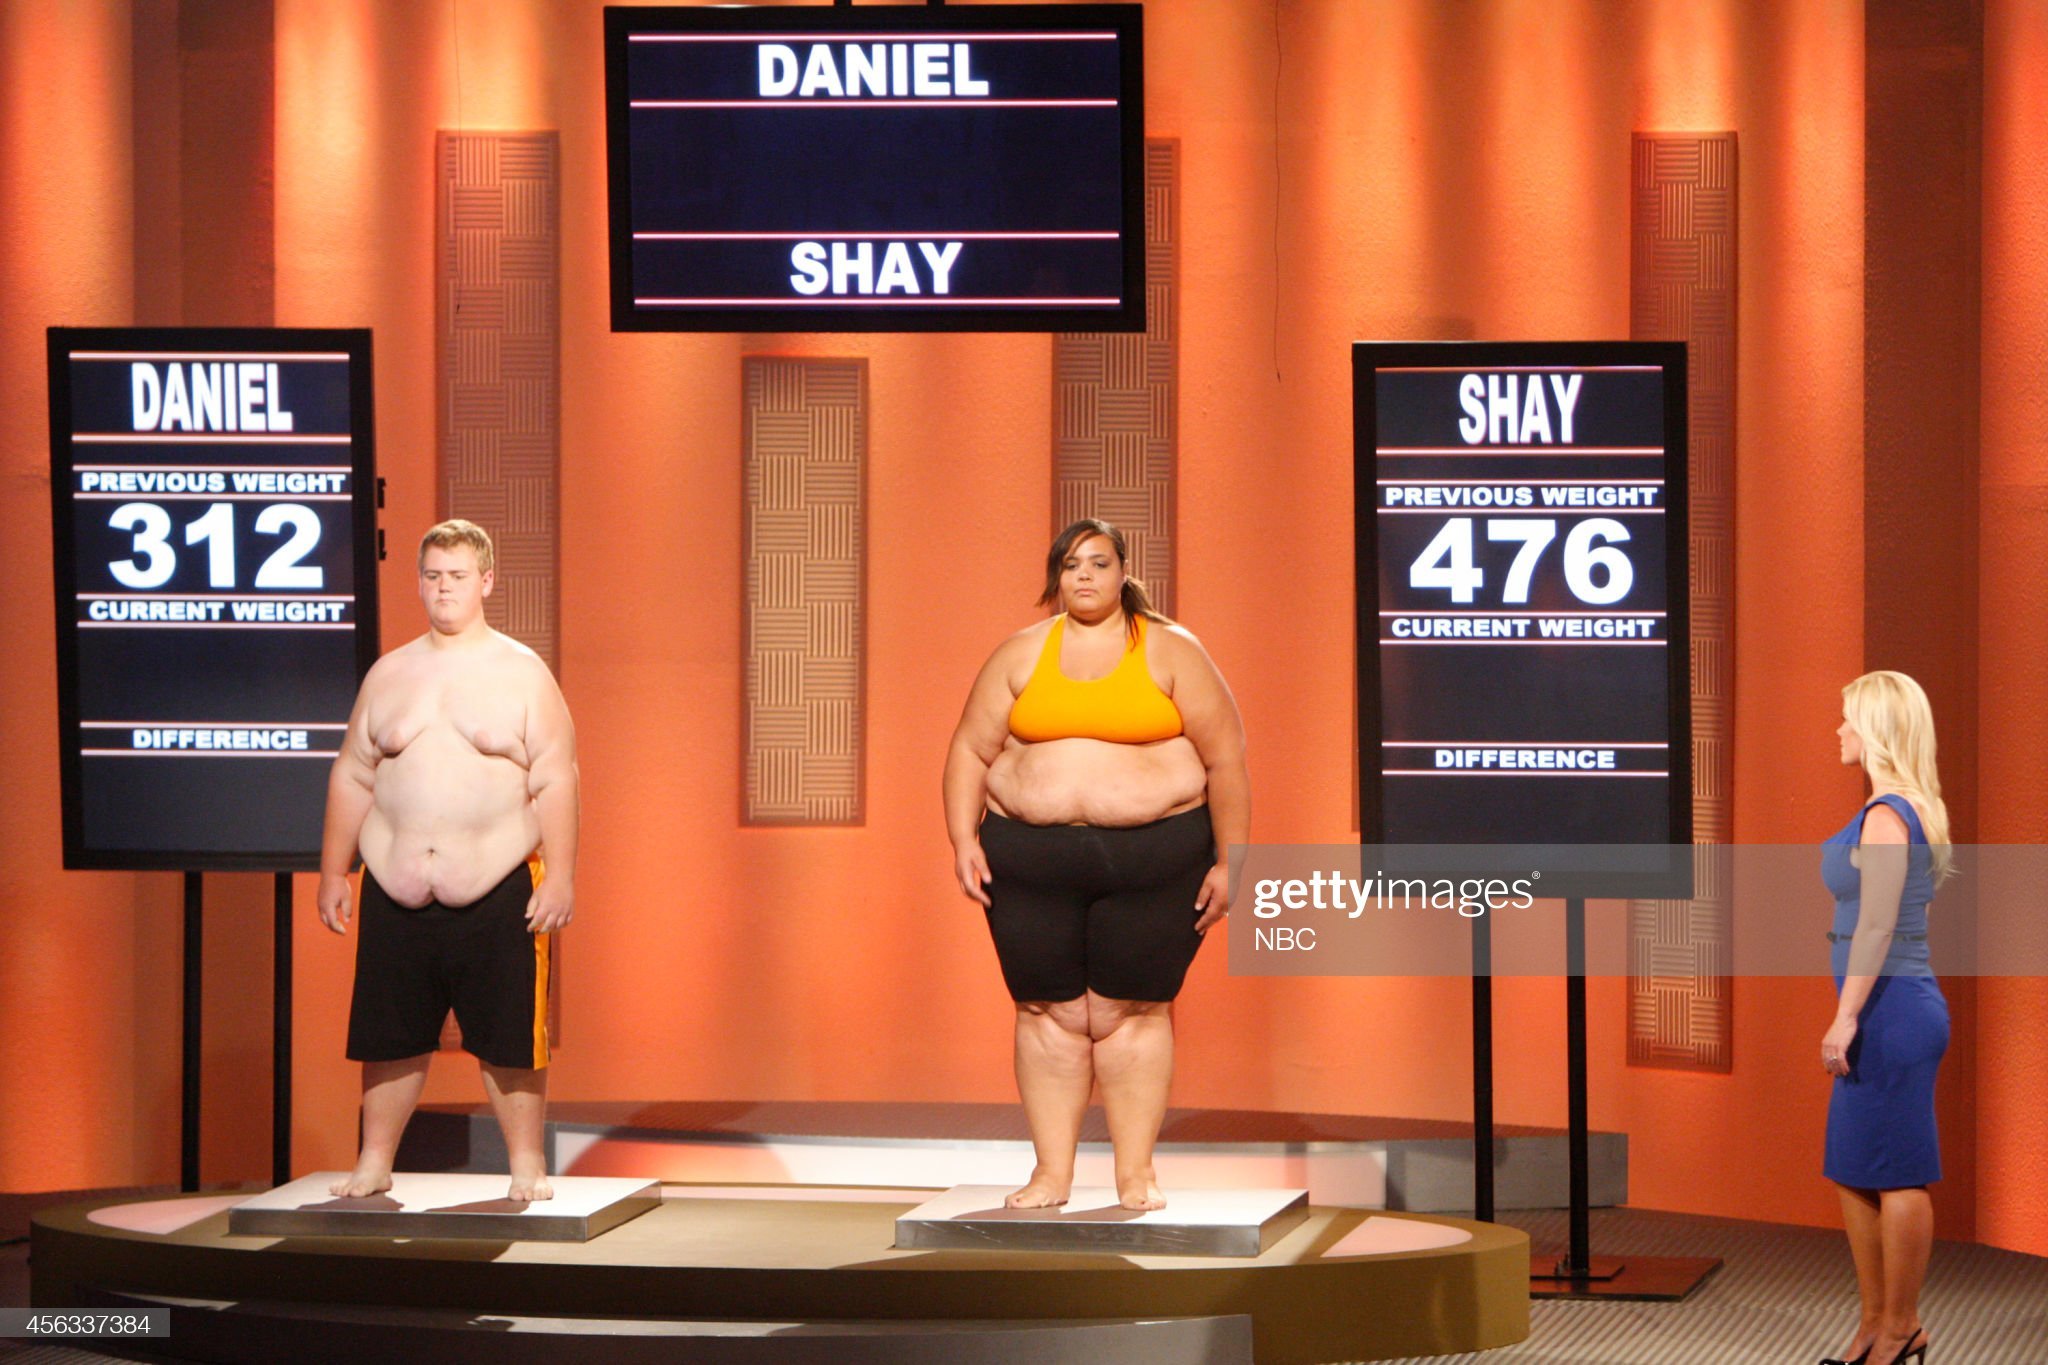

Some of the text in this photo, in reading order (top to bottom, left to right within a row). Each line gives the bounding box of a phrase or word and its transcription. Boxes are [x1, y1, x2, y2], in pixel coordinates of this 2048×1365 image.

[759, 44, 989, 97] DANIEL
[790, 242, 963, 295] SHAY
[131, 362, 293, 431] DANIEL
[1458, 373, 1583, 444] SHAY
[81, 472, 346, 494] PREVIOUS WEIGHT
[1385, 486, 1658, 506] PREVIOUS WEIGHT
[108, 502, 324, 588] 312
[1409, 517, 1634, 605] 476
[89, 600, 345, 622] CURRENT WEIGHT
[1391, 618, 1656, 638] CURRENT WEIGHT
[132, 730, 308, 751] DIFFERENCE
[1435, 749, 1615, 769] DIFFERENCE
